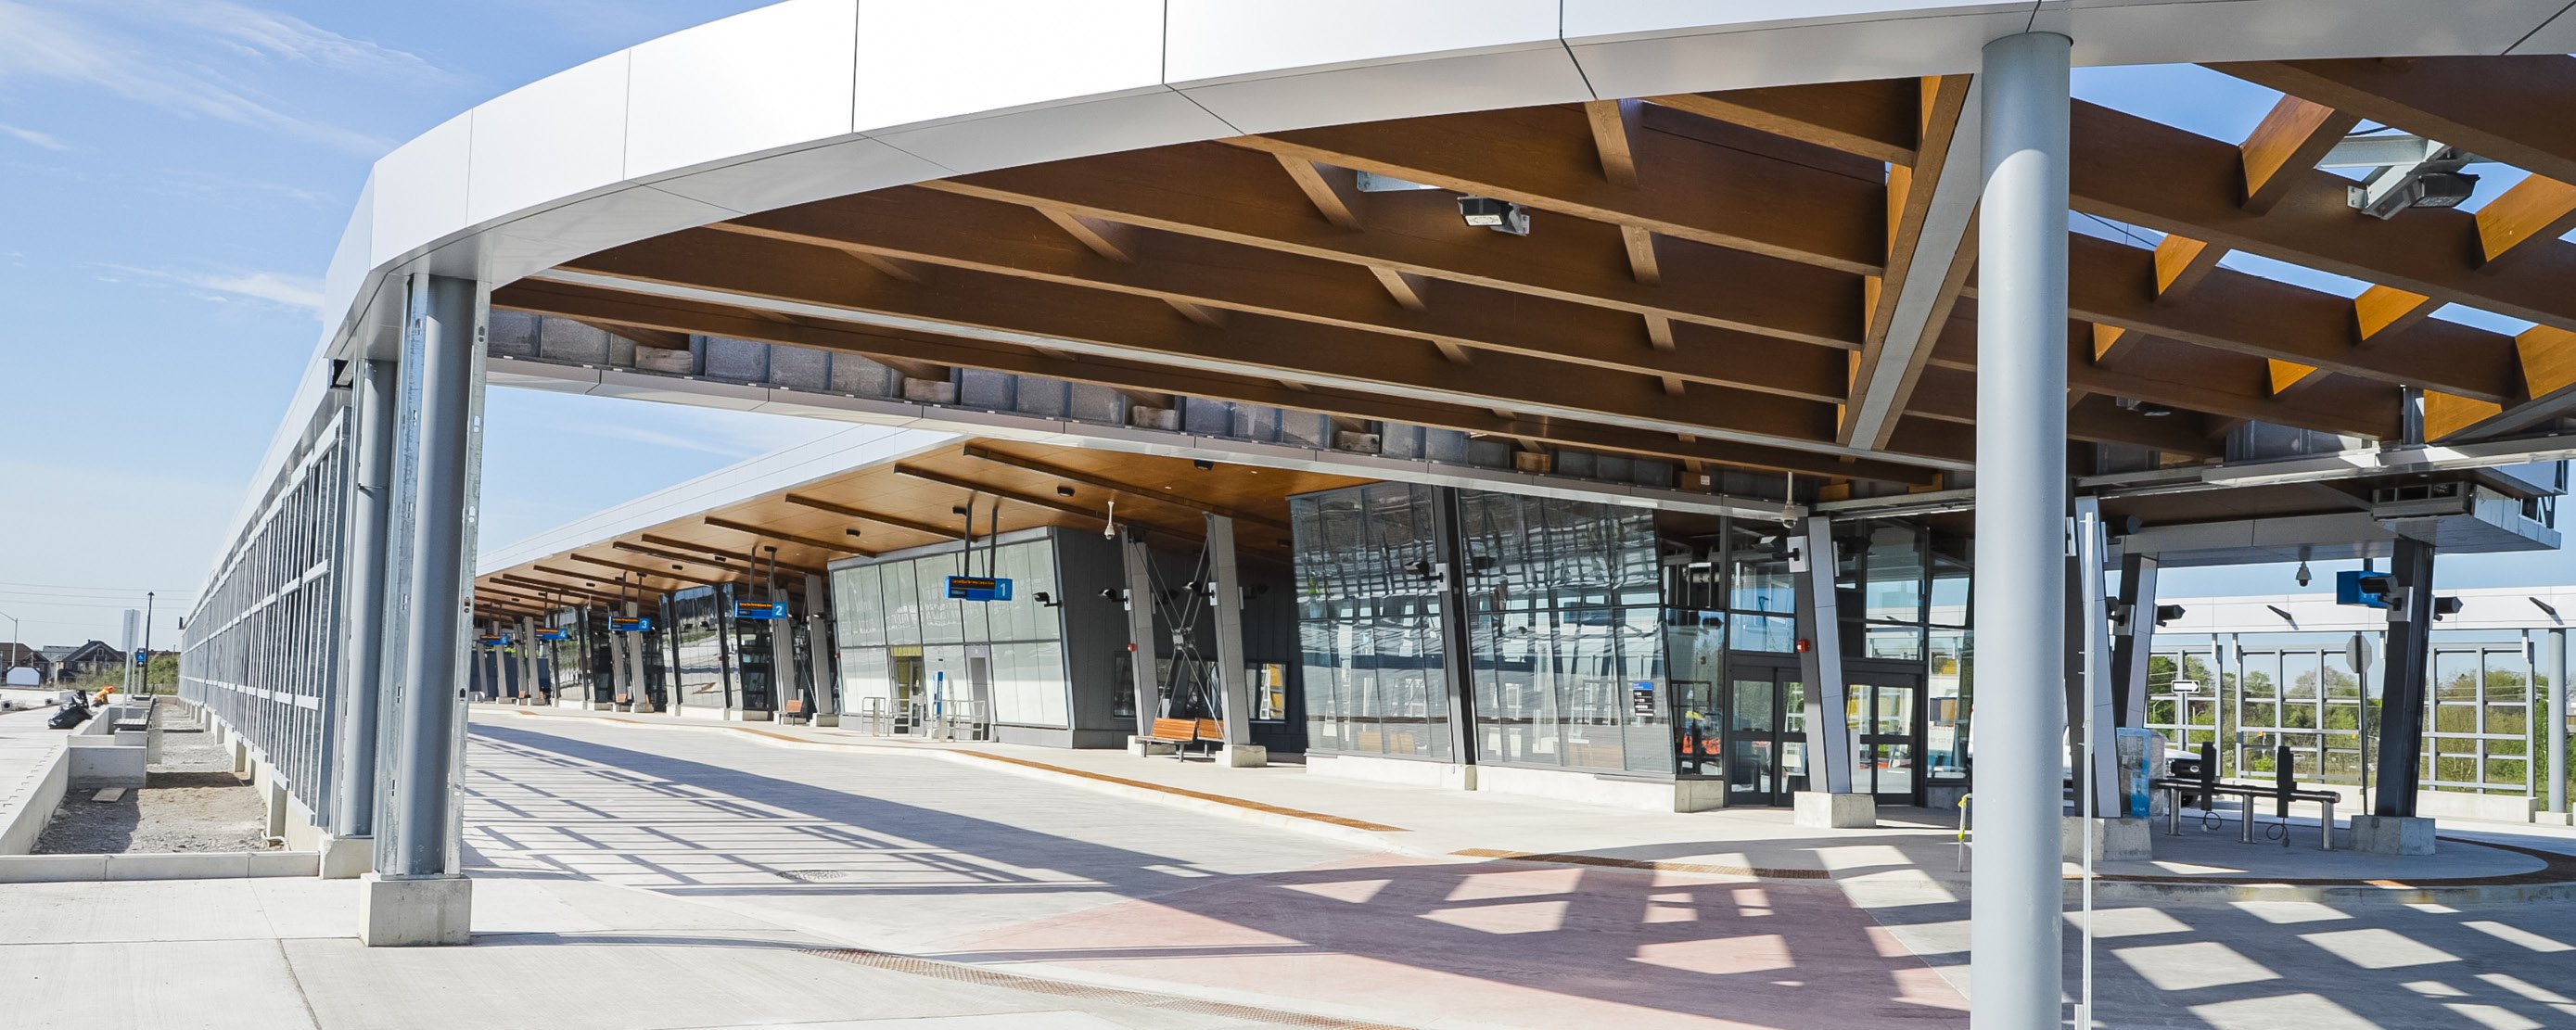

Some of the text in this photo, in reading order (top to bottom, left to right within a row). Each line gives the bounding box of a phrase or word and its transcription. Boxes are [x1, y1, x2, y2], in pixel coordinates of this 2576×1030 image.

[1000, 582, 1006, 597] 1
[775, 604, 783, 616] 2
[641, 619, 647, 629] 3
